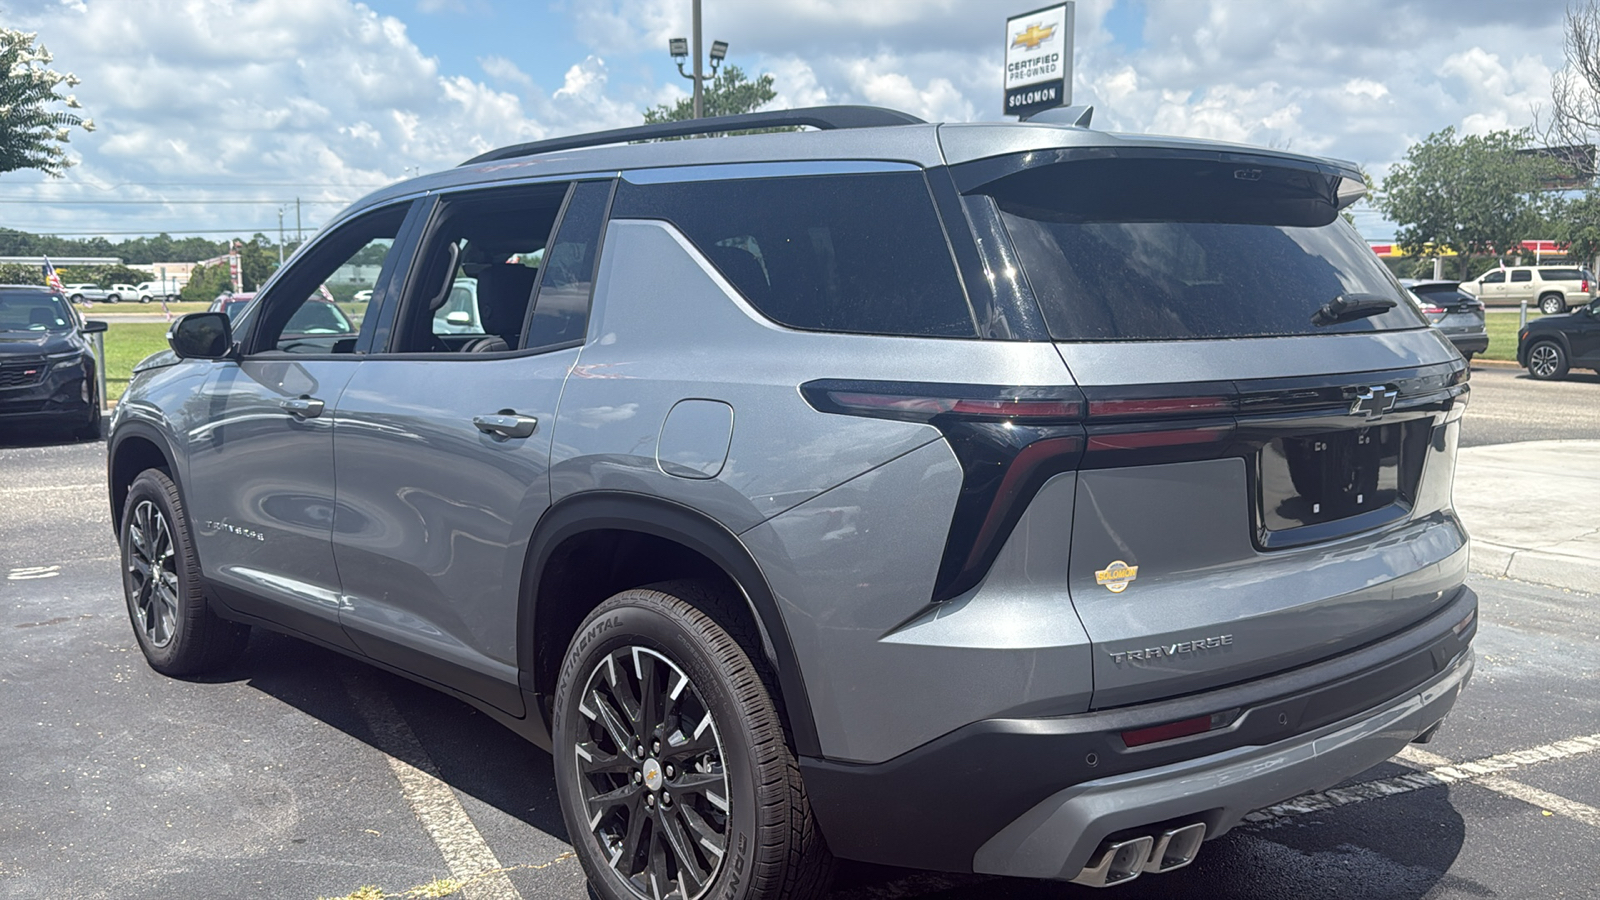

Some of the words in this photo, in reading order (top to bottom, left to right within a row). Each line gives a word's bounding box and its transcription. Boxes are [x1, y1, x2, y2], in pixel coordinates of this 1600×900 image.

[1008, 53, 1059, 72] CERTIFIED
[1009, 63, 1056, 81] PRE-OWNED
[1009, 88, 1056, 107] SOLOMON
[1098, 568, 1136, 581] SOLOMON
[1109, 634, 1233, 663] TRAVERSE
[555, 616, 624, 731] CONTINENTAL
